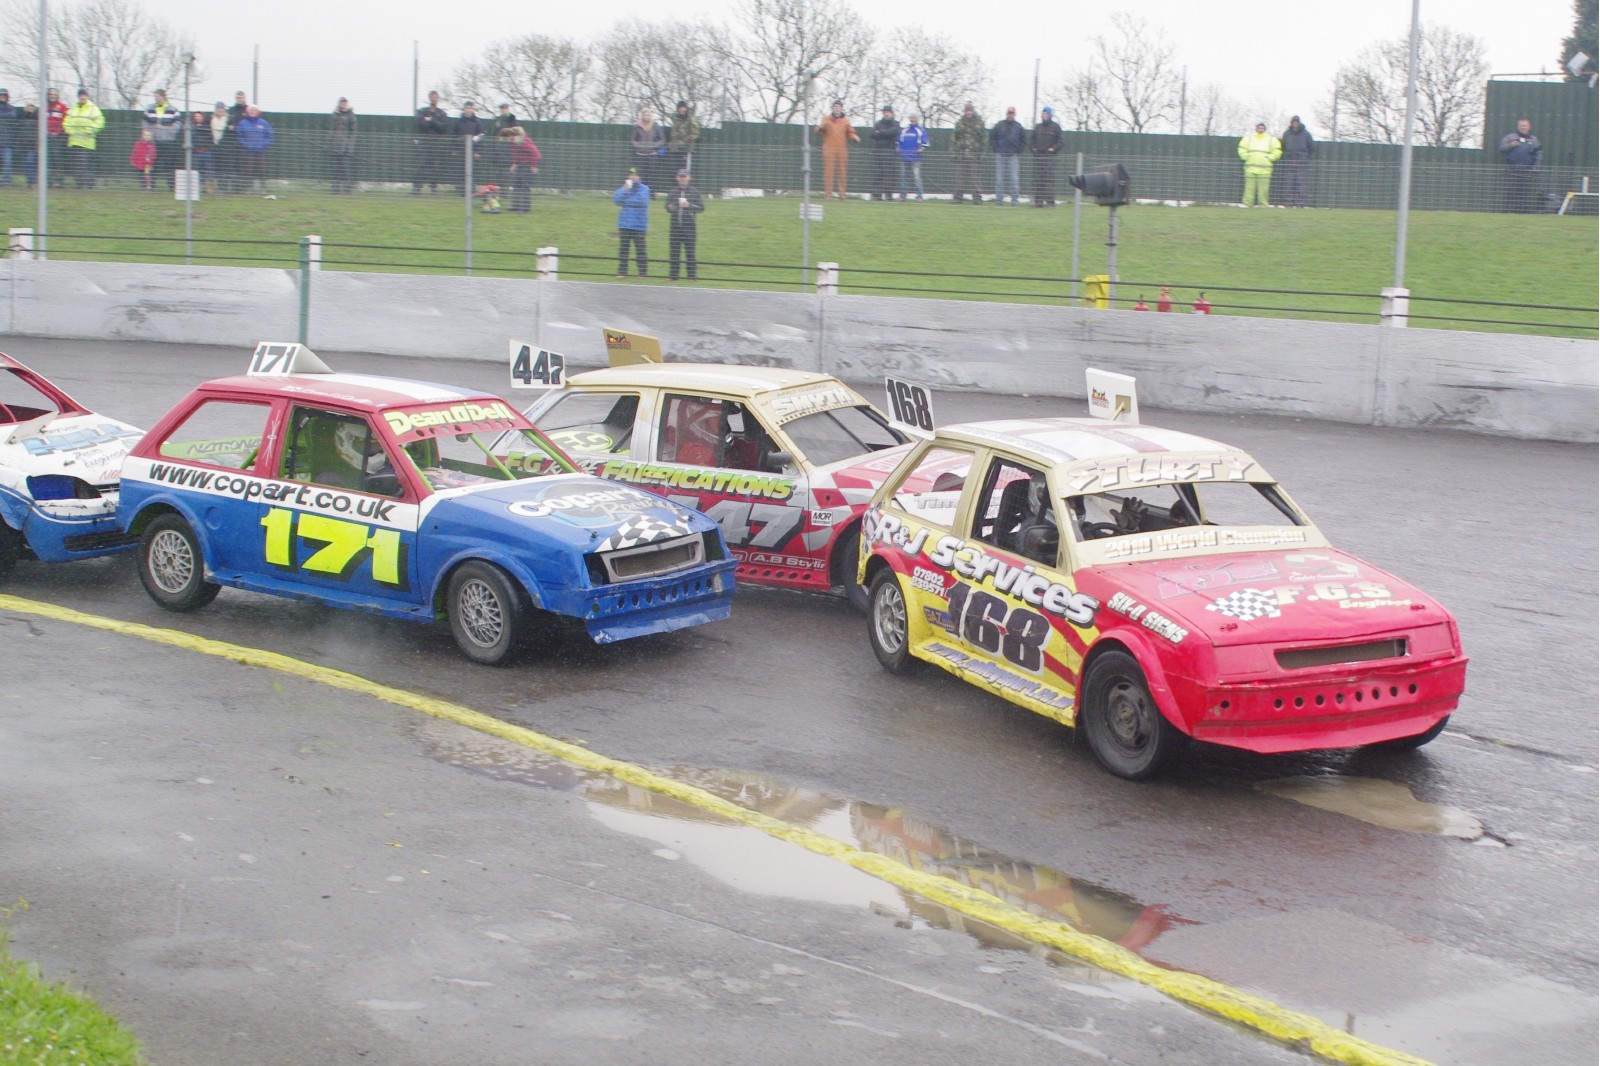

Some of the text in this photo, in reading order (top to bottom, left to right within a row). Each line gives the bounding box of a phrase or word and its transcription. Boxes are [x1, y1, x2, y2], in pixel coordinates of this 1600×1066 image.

[253, 345, 296, 373] 171
[512, 345, 564, 385] 447
[888, 379, 934, 432] 168
[187, 438, 261, 455] NATIONA
[149, 463, 397, 522] www.copart.co.uk
[601, 460, 794, 500] FABRICATIONS
[1067, 455, 1256, 490] STURTY
[508, 486, 652, 518] Copart
[668, 495, 805, 549] 47
[813, 512, 832, 521] MOR
[260, 507, 402, 586] 171
[873, 513, 932, 558] R&J
[929, 534, 1100, 625] Services
[913, 565, 945, 587] 07802
[1275, 580, 1392, 605] F.G.S
[945, 580, 1052, 675] 168
